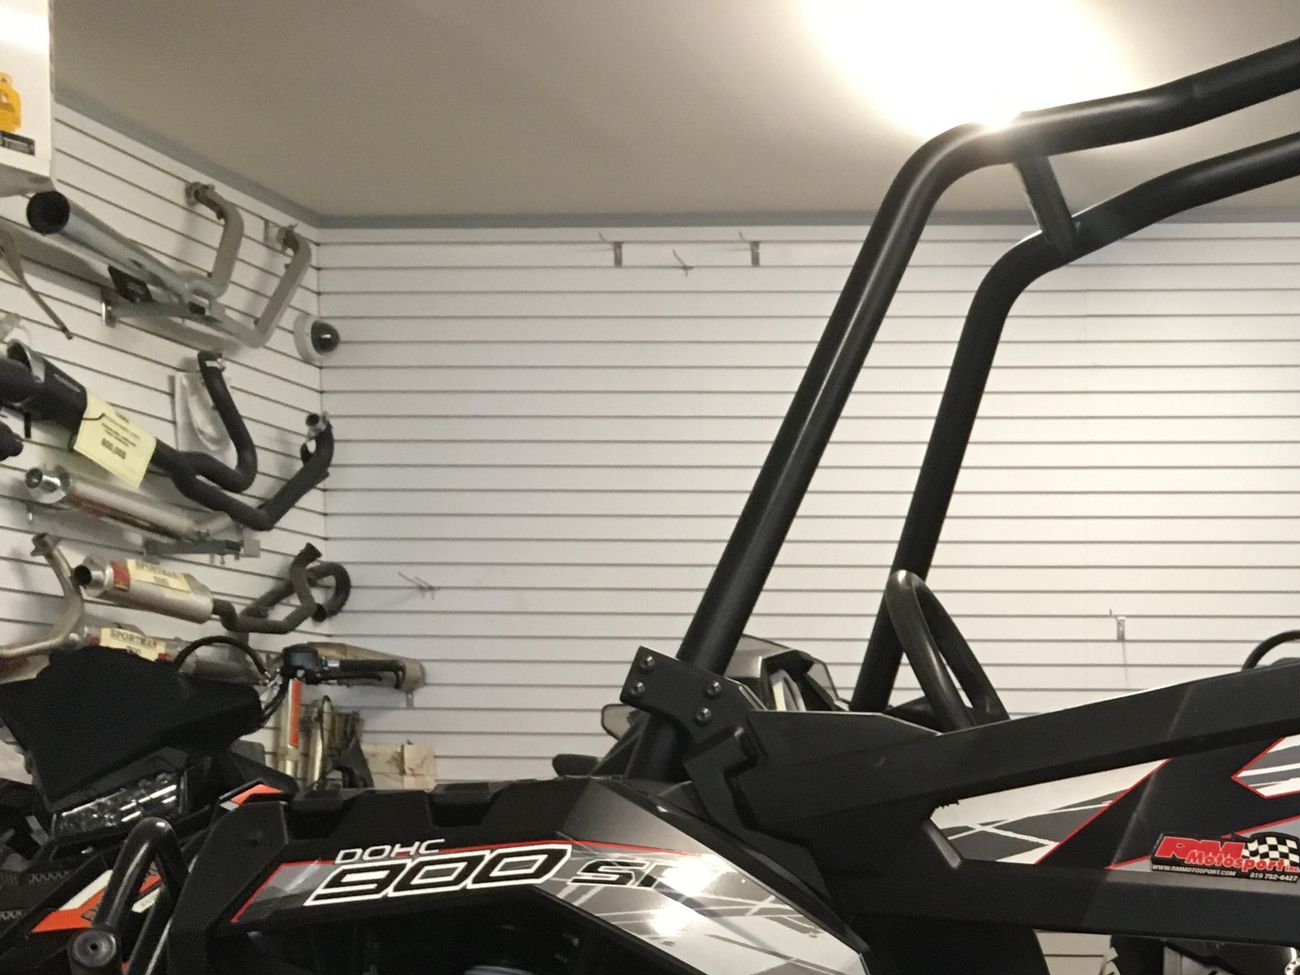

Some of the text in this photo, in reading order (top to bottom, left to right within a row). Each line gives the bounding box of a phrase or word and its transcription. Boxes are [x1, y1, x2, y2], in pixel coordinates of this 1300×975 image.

[334, 838, 446, 865] DOHC
[1155, 836, 1245, 860] RM
[1185, 848, 1285, 872] Motosport
[303, 844, 573, 906] 900
